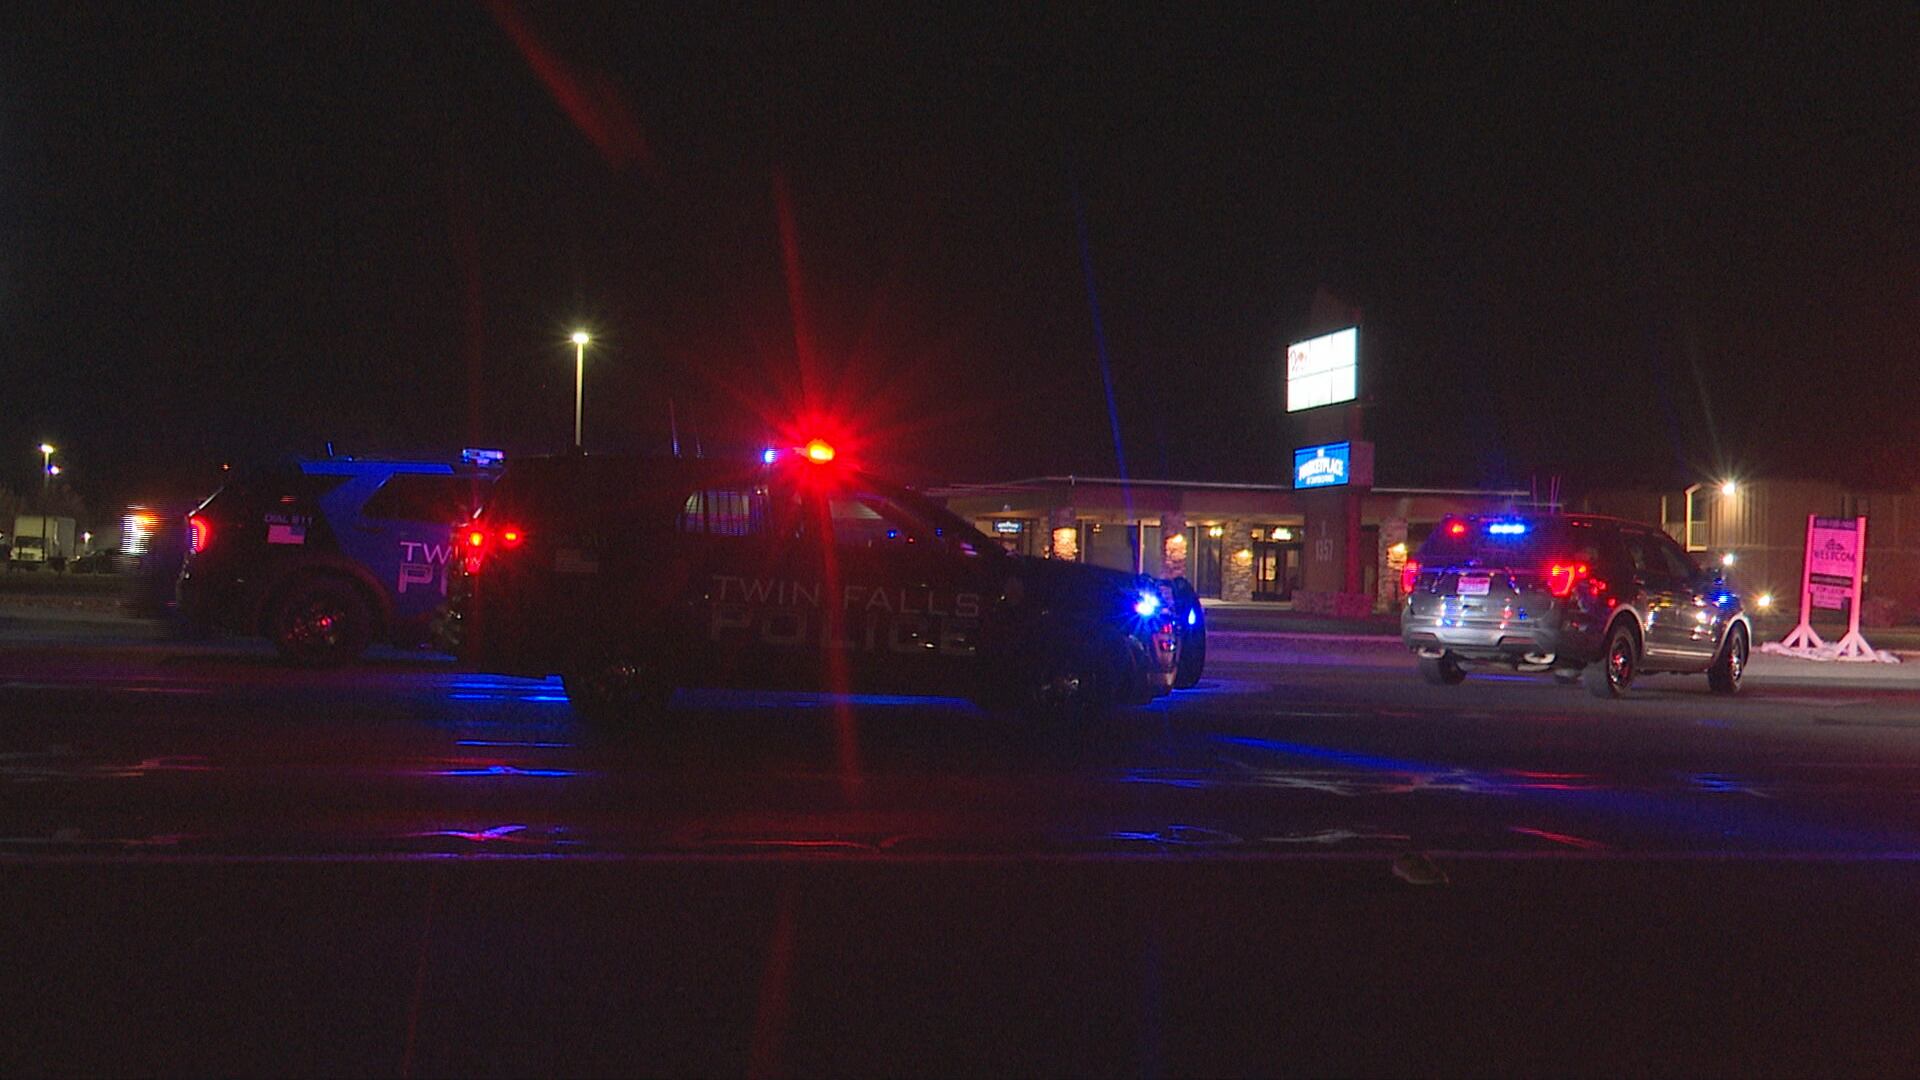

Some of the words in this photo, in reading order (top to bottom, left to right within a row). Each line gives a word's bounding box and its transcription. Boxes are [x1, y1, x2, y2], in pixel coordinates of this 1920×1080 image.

[712, 575, 821, 607] TWIN
[843, 586, 980, 618] FALLS
[709, 604, 977, 656] POLICE
